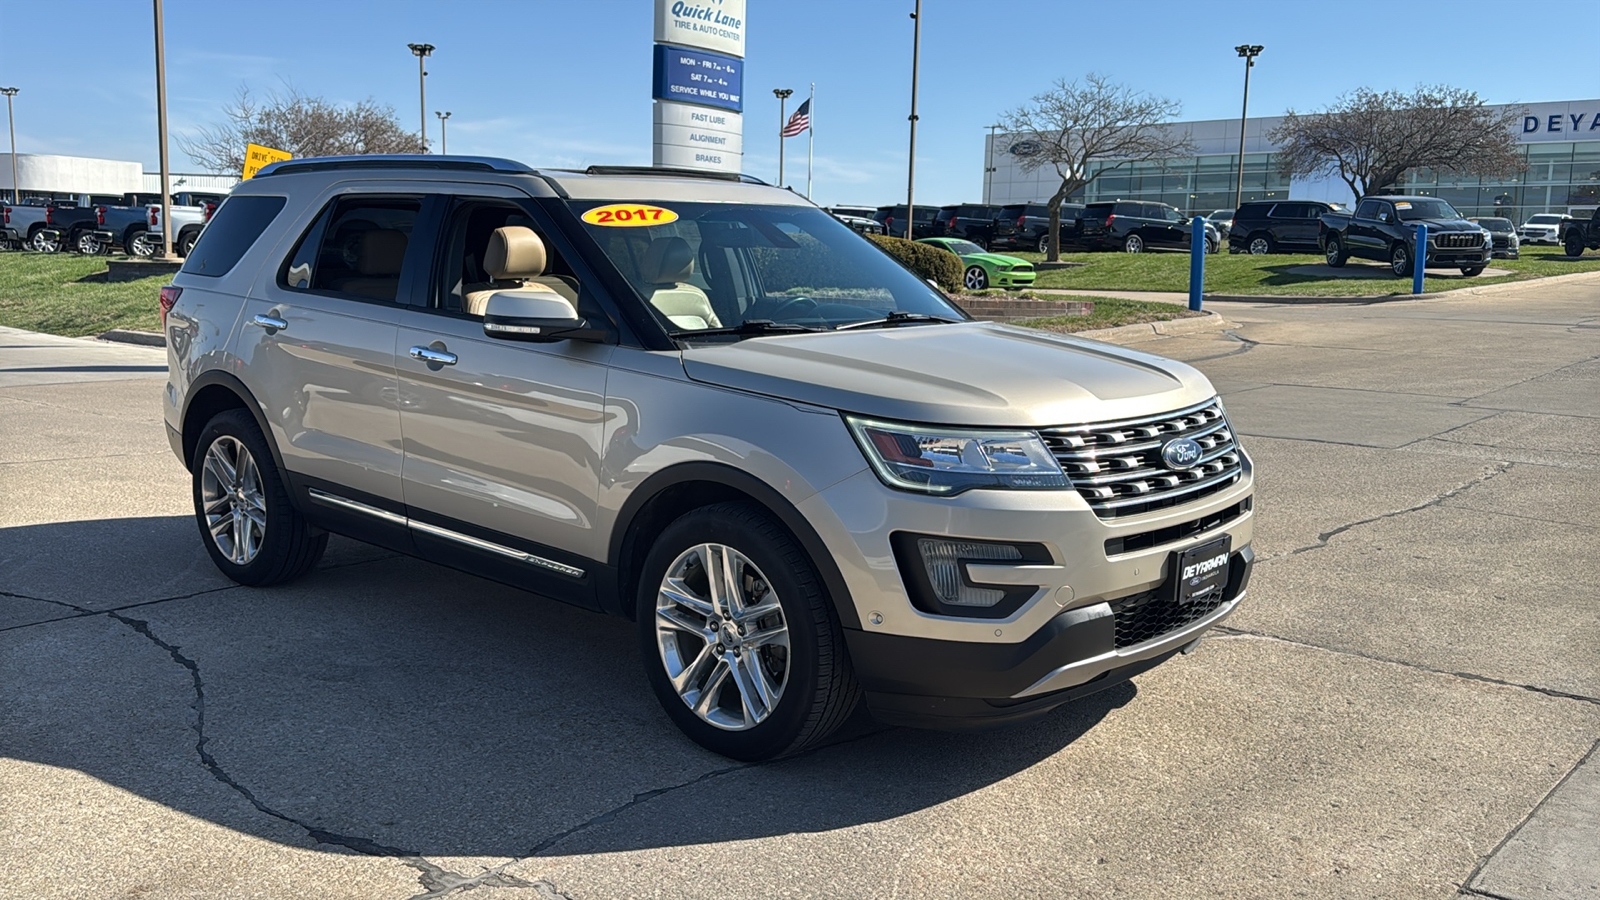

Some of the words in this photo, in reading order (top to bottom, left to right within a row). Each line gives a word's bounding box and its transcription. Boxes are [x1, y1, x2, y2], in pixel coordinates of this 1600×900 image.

[671, 1, 714, 21] Quick
[714, 10, 742, 29] Lane
[673, 19, 691, 30] TIRE
[692, 23, 698, 31] &
[699, 25, 718, 35] AUTO
[718, 29, 740, 41] CENTER
[680, 57, 696, 66] MON
[702, 60, 712, 69] FRI
[690, 73, 702, 81] SAT
[670, 84, 698, 96] SERVICE
[699, 89, 717, 99] WHILE
[718, 92, 729, 101] YOU
[691, 112, 708, 122] FAST
[709, 115, 726, 125] LUBE
[689, 133, 726, 145] ALIGNMENT
[251, 151, 268, 163] DRIVE
[695, 153, 721, 164] BRAKES
[595, 209, 664, 223] 2017
[1176, 443, 1197, 462] Ford
[1182, 552, 1229, 580] DEYARMAN
